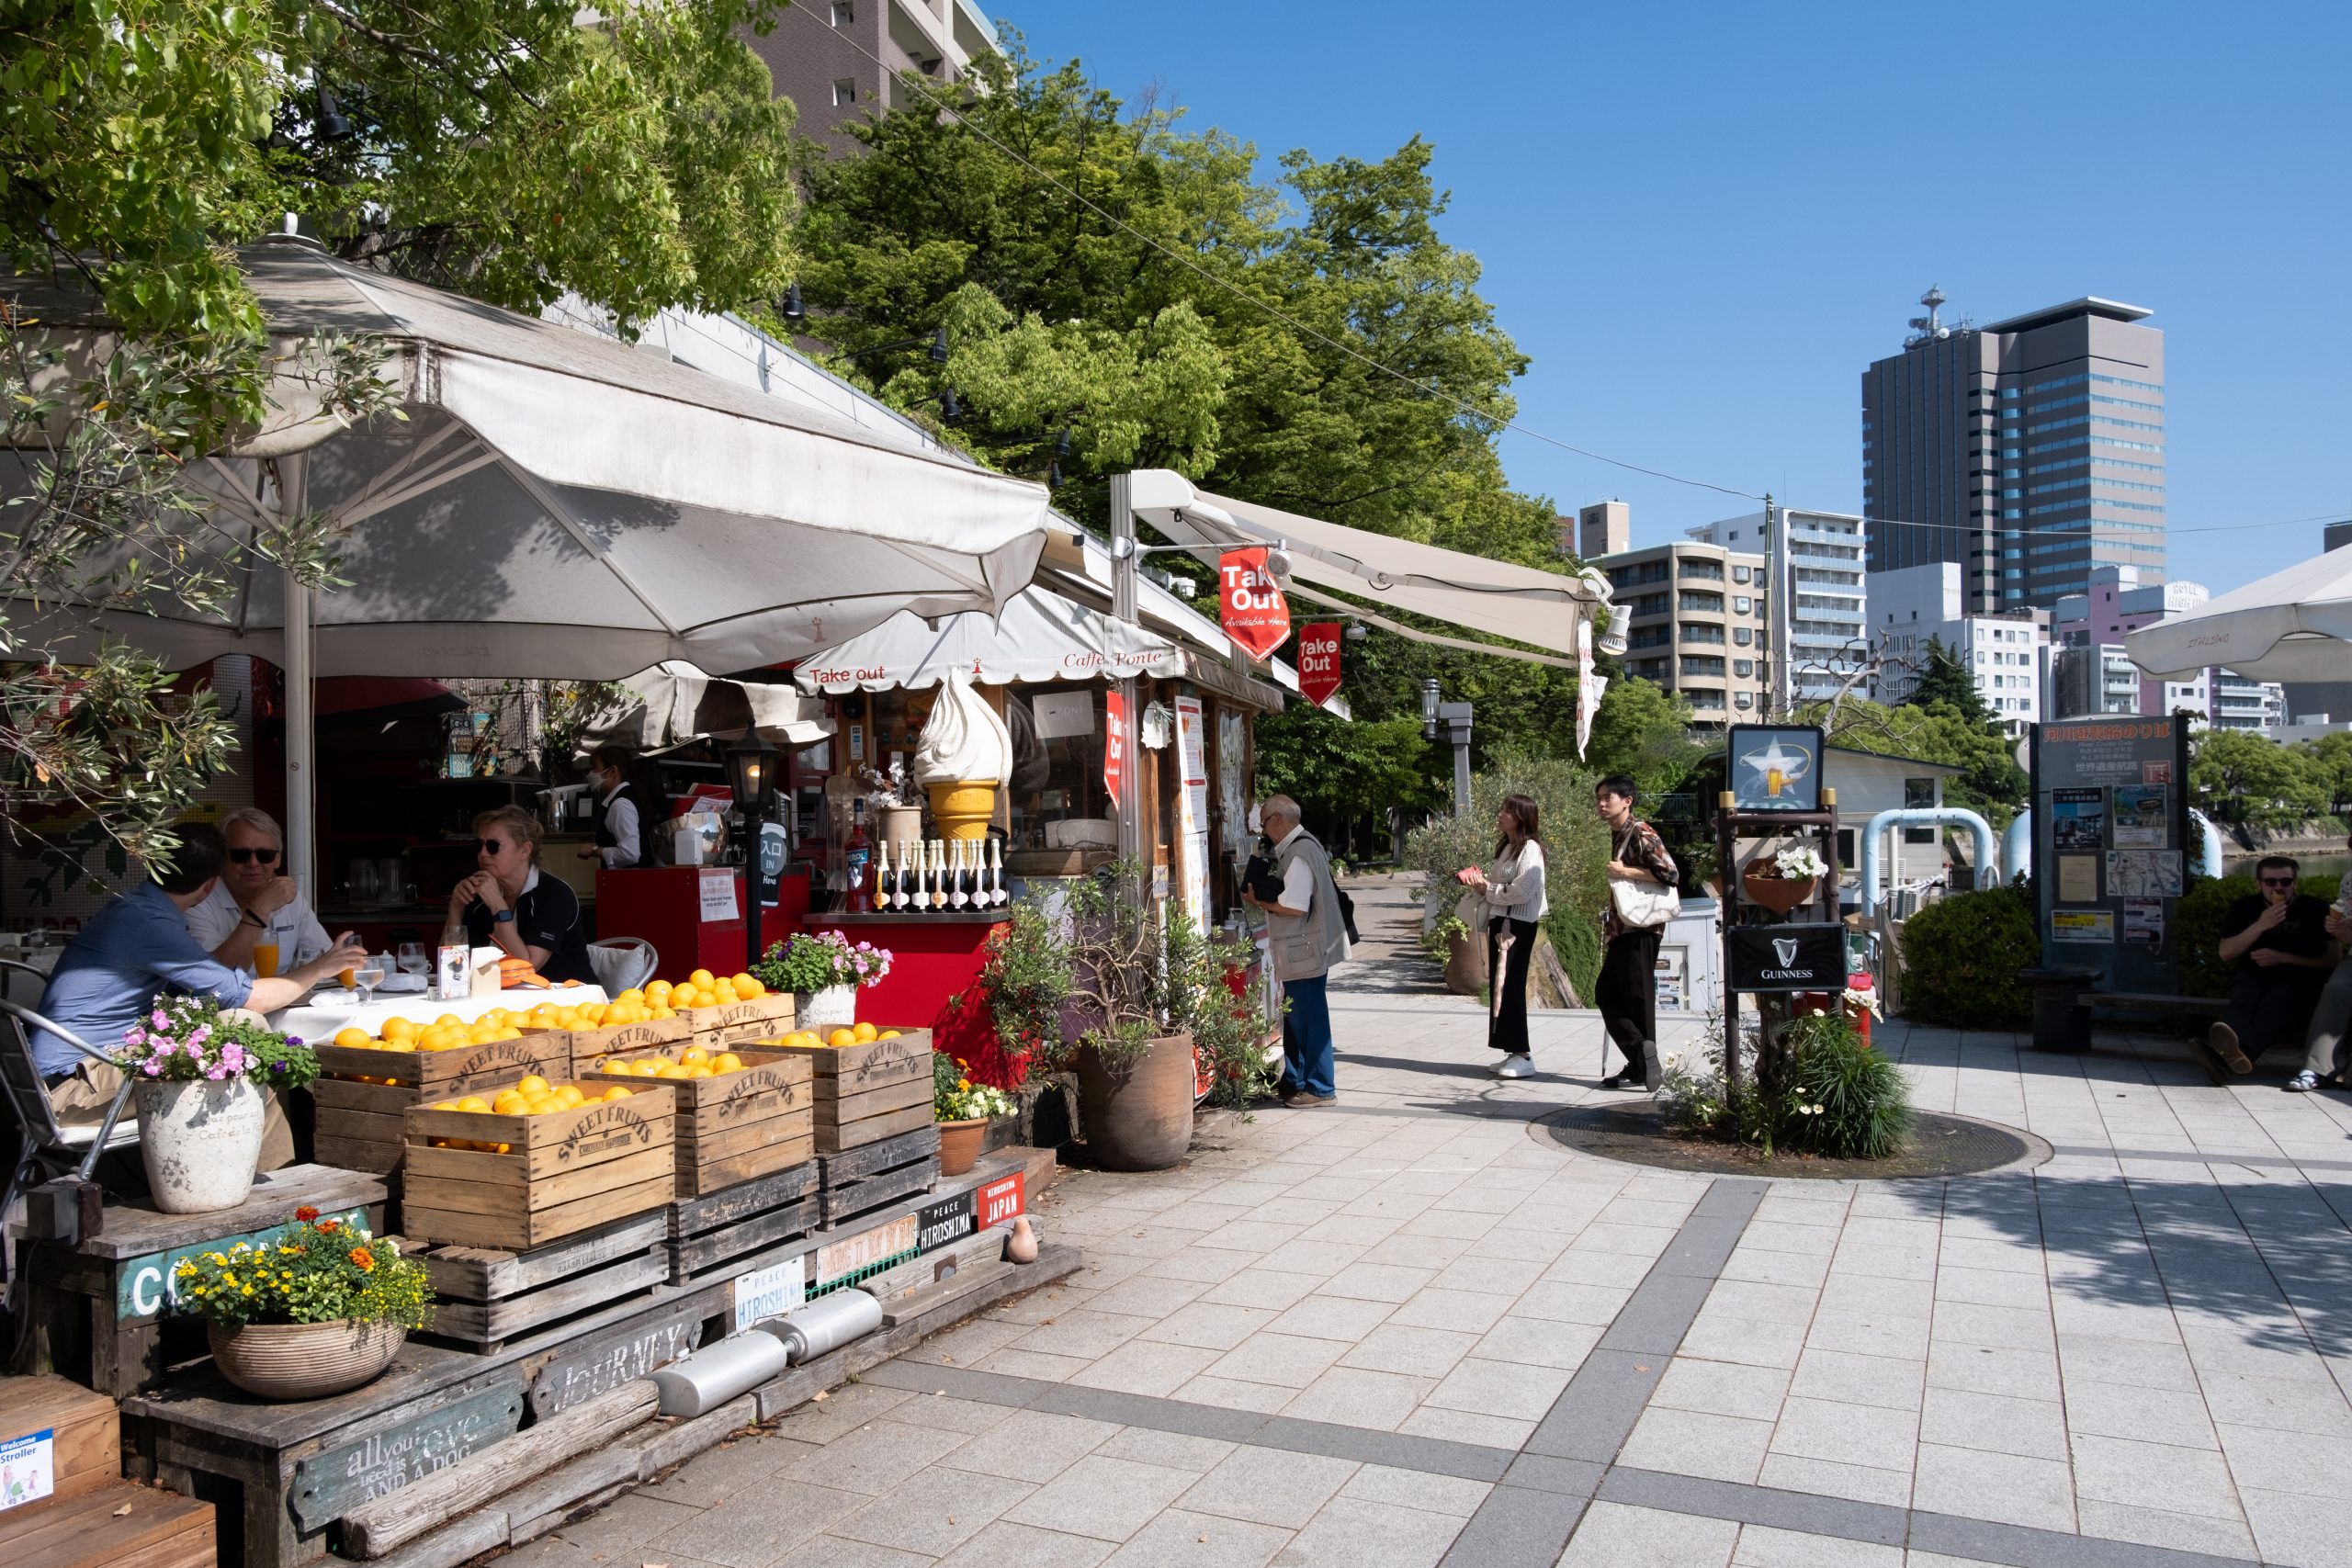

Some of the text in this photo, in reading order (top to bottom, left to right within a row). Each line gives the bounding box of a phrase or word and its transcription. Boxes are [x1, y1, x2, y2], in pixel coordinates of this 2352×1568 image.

[1223, 566, 1278, 588] Tak
[2173, 583, 2198, 595] HOTEL
[1231, 589, 1280, 611] Out
[2168, 595, 2196, 610] HIGH
[1226, 616, 1287, 626] Available Here
[1300, 637, 1338, 657] Take
[1116, 652, 1162, 666] Ponte
[1303, 657, 1331, 672] Out
[809, 666, 886, 683] Take out
[761, 840, 781, 857] 入口
[765, 860, 775, 870] IN
[763, 875, 776, 886] Here
[1761, 969, 1813, 979] GUINNESS
[710, 1006, 741, 1045] SWEET
[743, 1005, 776, 1035] FRUITS
[448, 1046, 494, 1094] SWEET
[497, 1044, 546, 1077] FRUITS
[856, 1043, 886, 1082] SWEET
[888, 1042, 919, 1074] FRUITS
[719, 1070, 795, 1117] SWEET FRUITS
[559, 1106, 653, 1163] SWEET FRUITS
[987, 1179, 1016, 1199] HIROSHIMA
[933, 1201, 958, 1219] PEACE
[987, 1193, 1017, 1223] JAPAN
[921, 1213, 970, 1250] HIROSHIMA
[754, 1267, 786, 1289] PEACE
[738, 1281, 802, 1326] HIROSHIMA
[1, 1437, 36, 1452] Welcome
[1, 1447, 37, 1464] Stroller
[347, 1433, 413, 1477] all you
[360, 1457, 406, 1487] need is
[365, 1445, 471, 1503] AND A DOG
